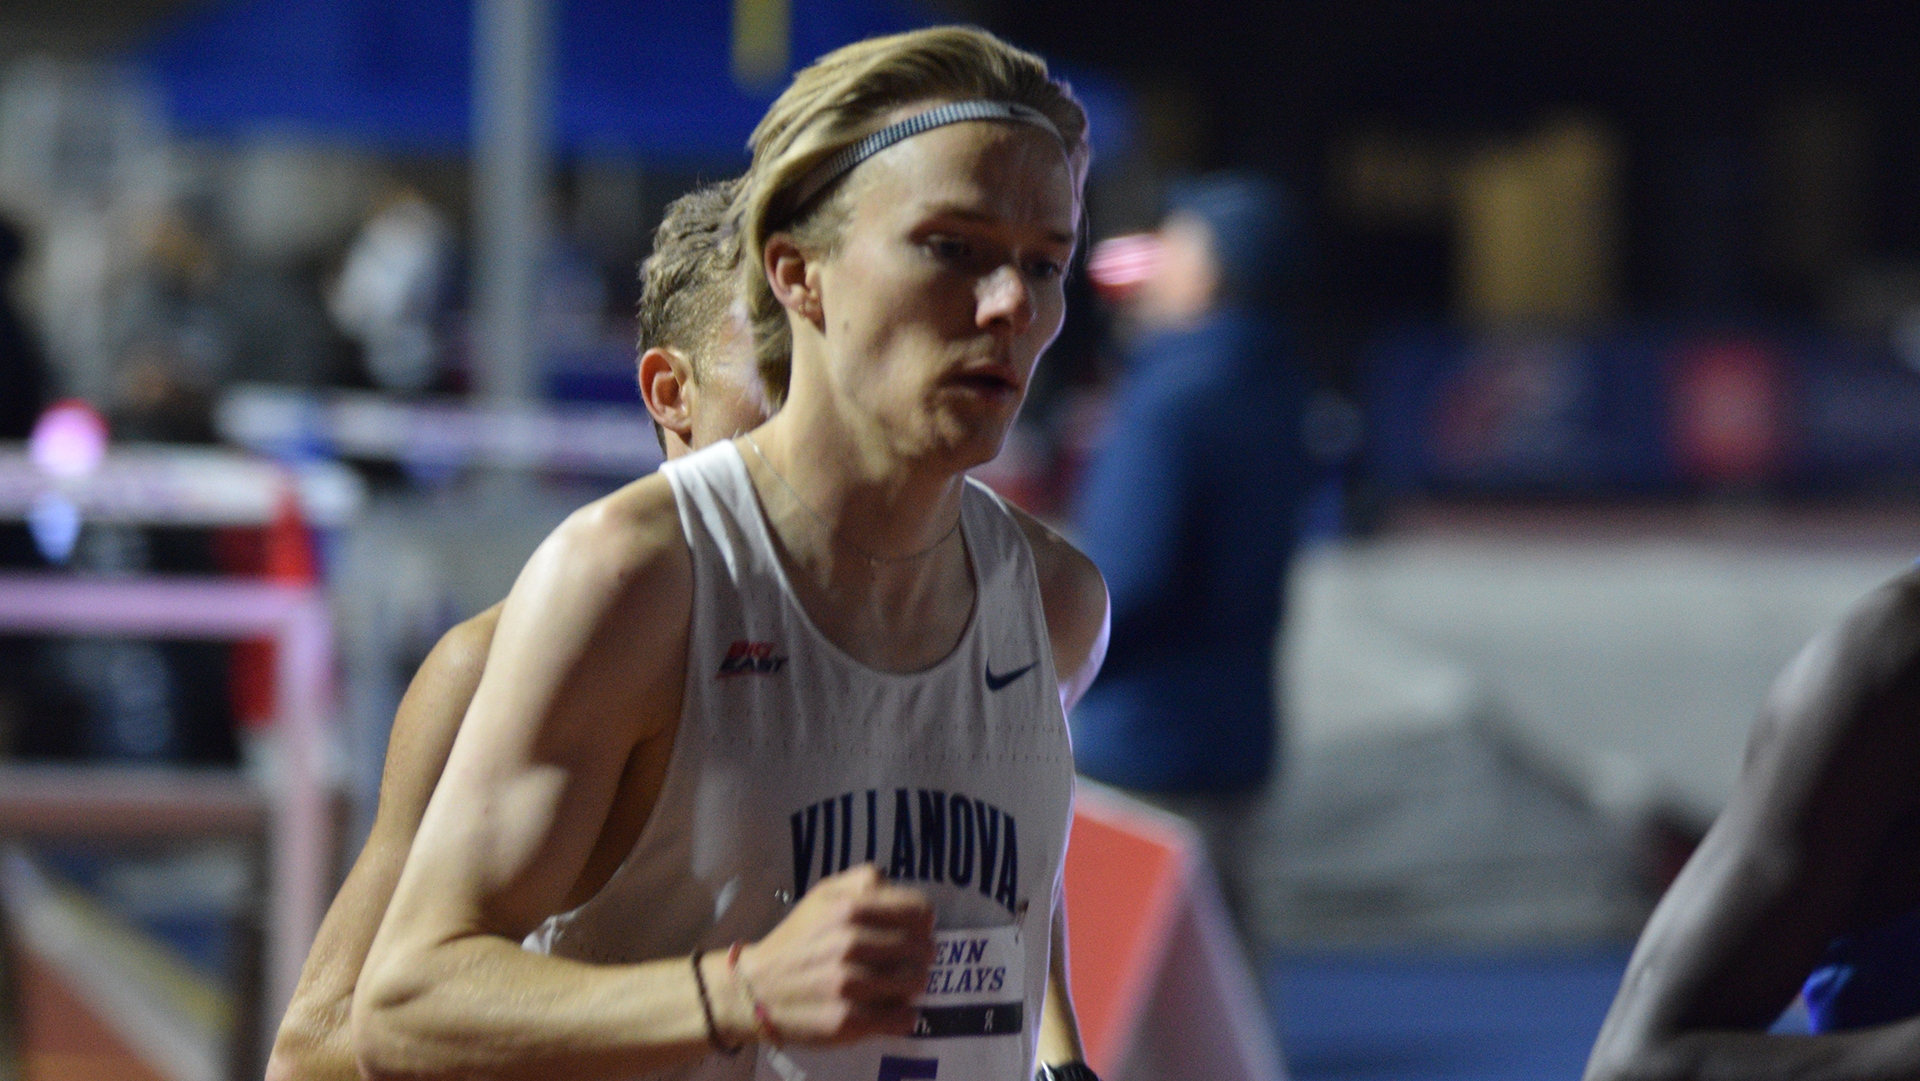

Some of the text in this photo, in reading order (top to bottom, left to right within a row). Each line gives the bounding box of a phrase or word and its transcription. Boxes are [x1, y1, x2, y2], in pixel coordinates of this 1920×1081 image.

[791, 788, 1018, 914] VILLANOVA
[934, 938, 988, 967] ENN
[926, 966, 1006, 995] ELAYS
